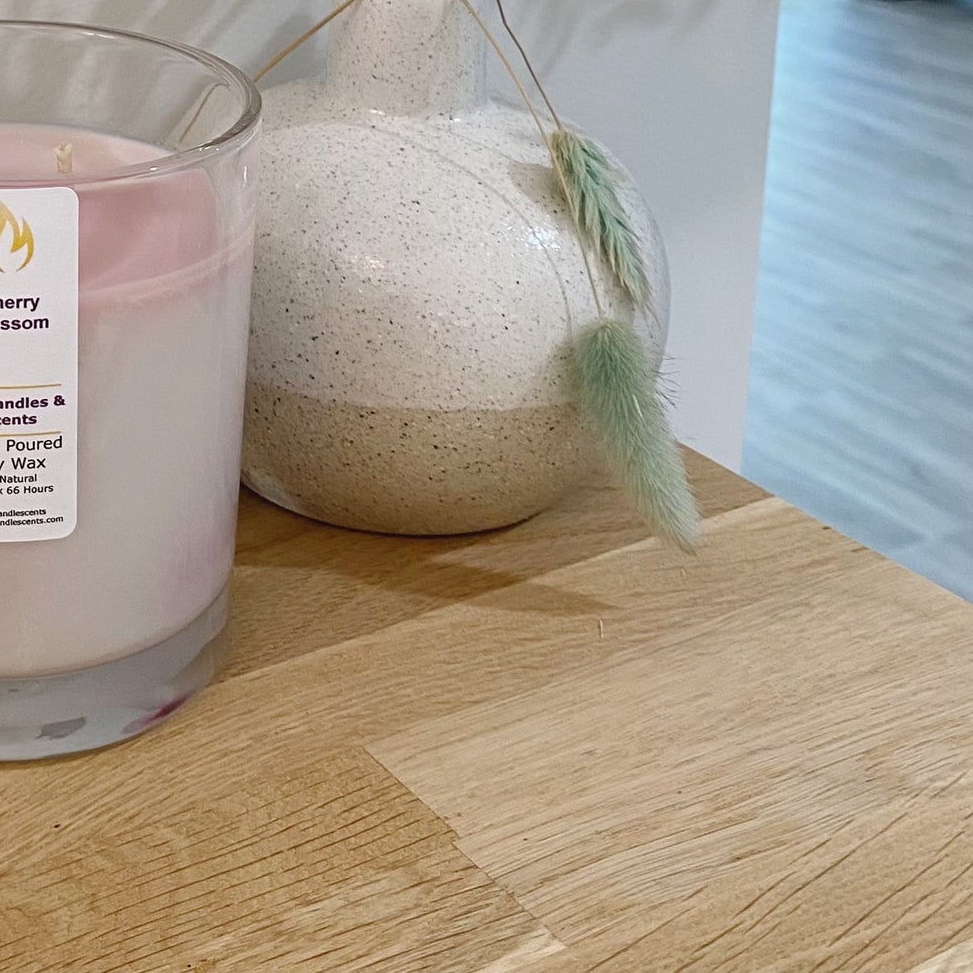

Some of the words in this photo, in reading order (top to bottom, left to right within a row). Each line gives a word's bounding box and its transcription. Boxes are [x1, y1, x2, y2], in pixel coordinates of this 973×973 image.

[53, 395, 66, 406] &
[6, 436, 63, 451] Poured
[11, 457, 46, 470] Wax
[0, 474, 37, 484] Natural
[7, 486, 20, 495] 66
[23, 485, 54, 494] Hours
